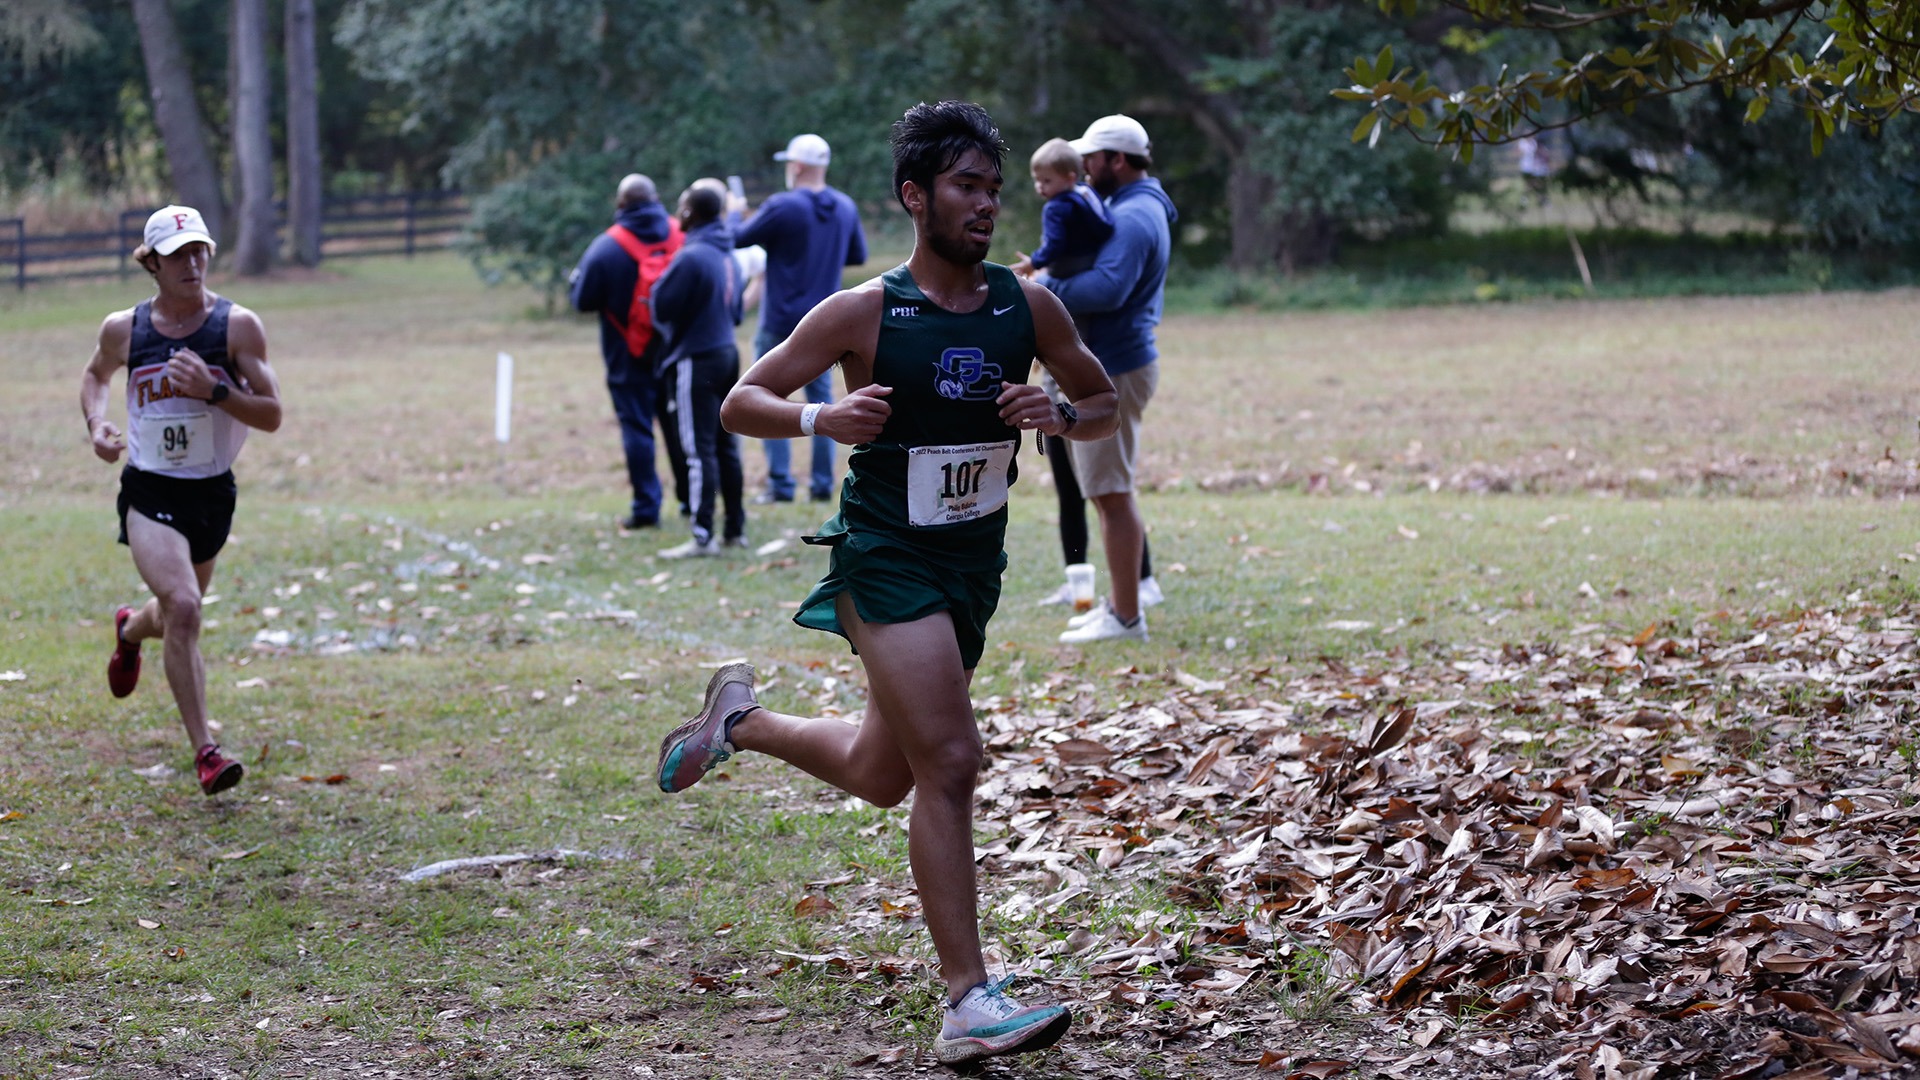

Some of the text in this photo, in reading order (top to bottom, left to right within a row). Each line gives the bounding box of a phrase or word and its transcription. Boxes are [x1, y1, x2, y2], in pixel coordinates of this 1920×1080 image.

[172, 213, 188, 231] F
[891, 306, 919, 317] PBC
[941, 347, 1002, 401] GC
[163, 424, 188, 451] 94
[941, 459, 987, 498] 107
[946, 510, 981, 521] Georgia College
